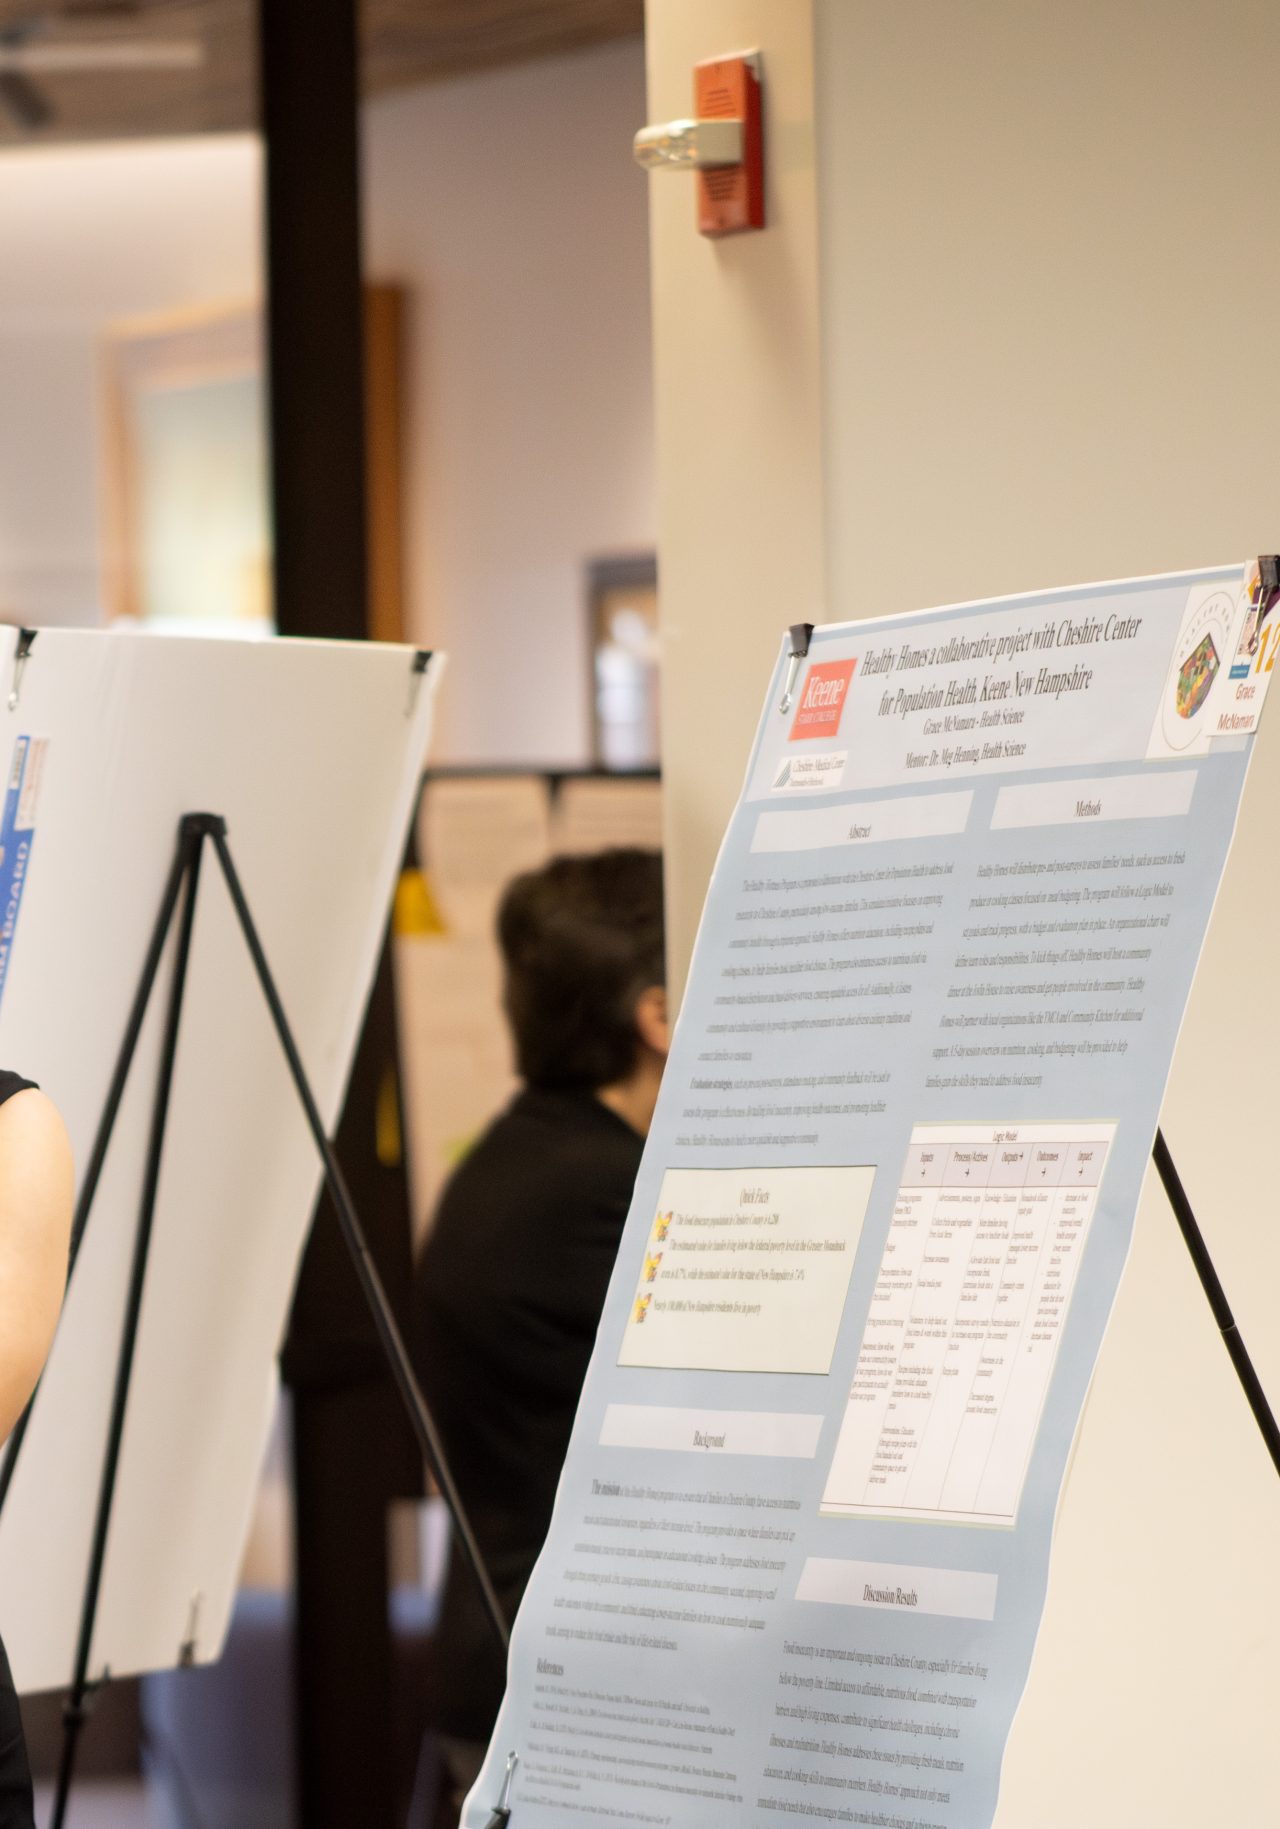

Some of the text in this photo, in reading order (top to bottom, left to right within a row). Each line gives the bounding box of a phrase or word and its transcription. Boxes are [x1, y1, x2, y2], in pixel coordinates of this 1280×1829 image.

[859, 614, 1143, 678] Healthy Homes a collaborative project with Cheshire Center
[803, 676, 844, 709] Keene
[878, 667, 1092, 719] for Population Health, Keene New Hampshire
[1236, 683, 1255, 700] Grace
[923, 718, 942, 733] Grace
[979, 709, 1000, 727] Health
[980, 742, 1001, 758] Health
[1075, 800, 1102, 817] Methods
[863, 1584, 917, 1606] Discussion Results
